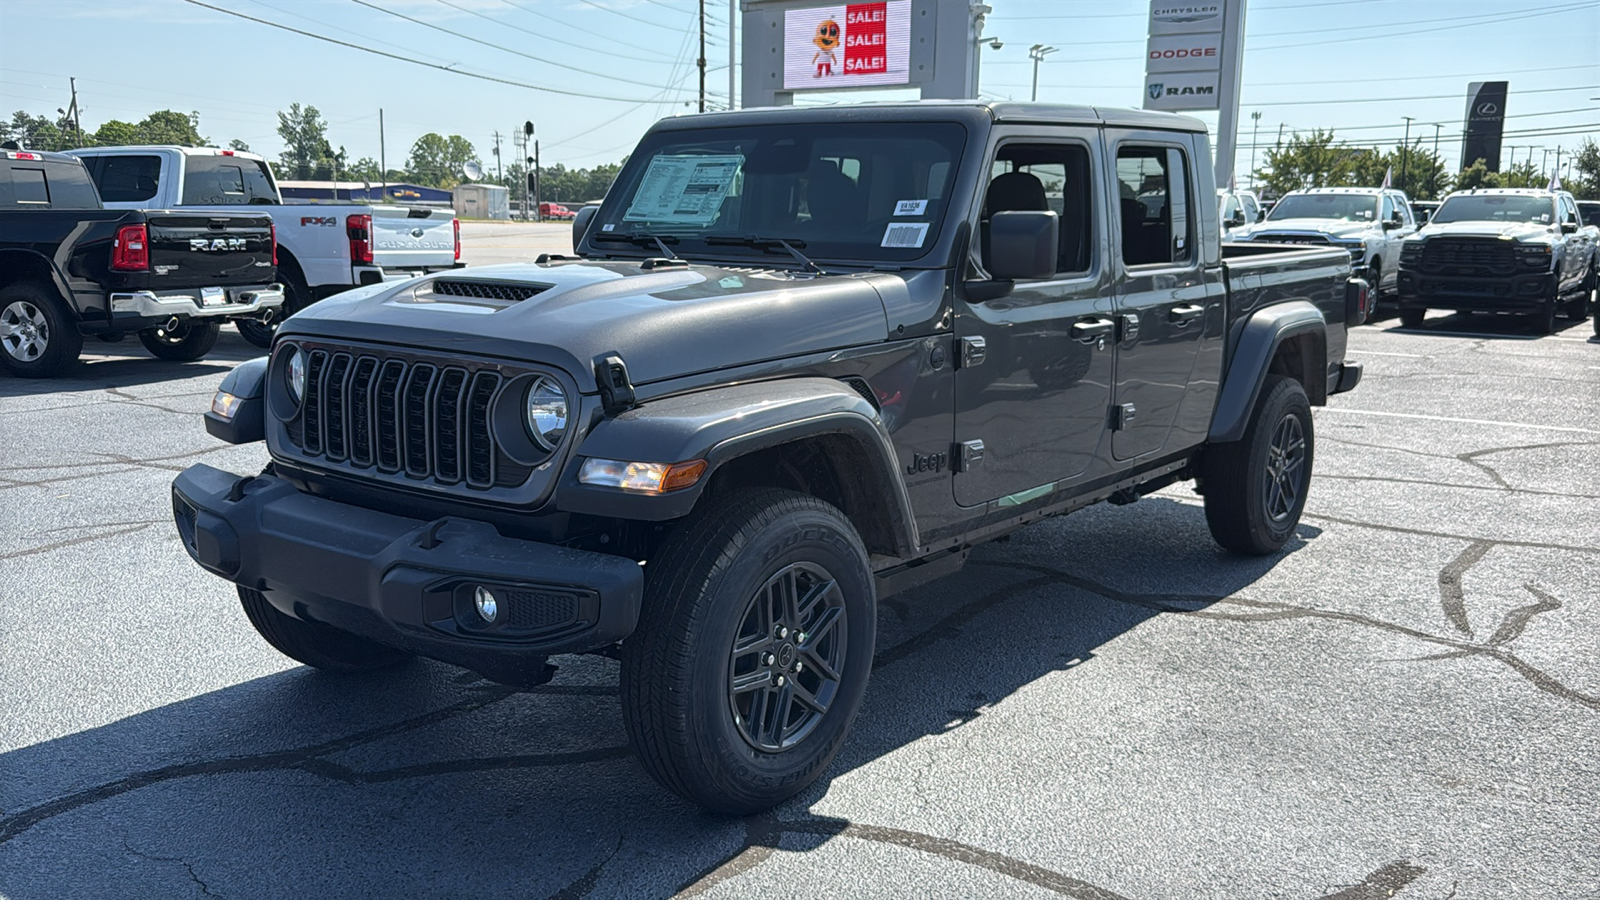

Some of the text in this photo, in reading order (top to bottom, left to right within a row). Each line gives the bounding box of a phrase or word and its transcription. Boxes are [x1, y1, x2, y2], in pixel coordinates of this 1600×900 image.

[847, 9, 885, 24] SALE!
[1153, 6, 1218, 16] CHRYSLER
[846, 32, 885, 47] SALE!
[1149, 47, 1217, 60] DODGE
[845, 55, 885, 71] SALE!
[1165, 86, 1214, 96] RAM
[300, 216, 337, 227] FX4
[189, 239, 247, 252] RAM
[378, 240, 453, 249] SUPER DUTY
[907, 452, 947, 476] Jeep
[762, 526, 862, 564] DUELER
